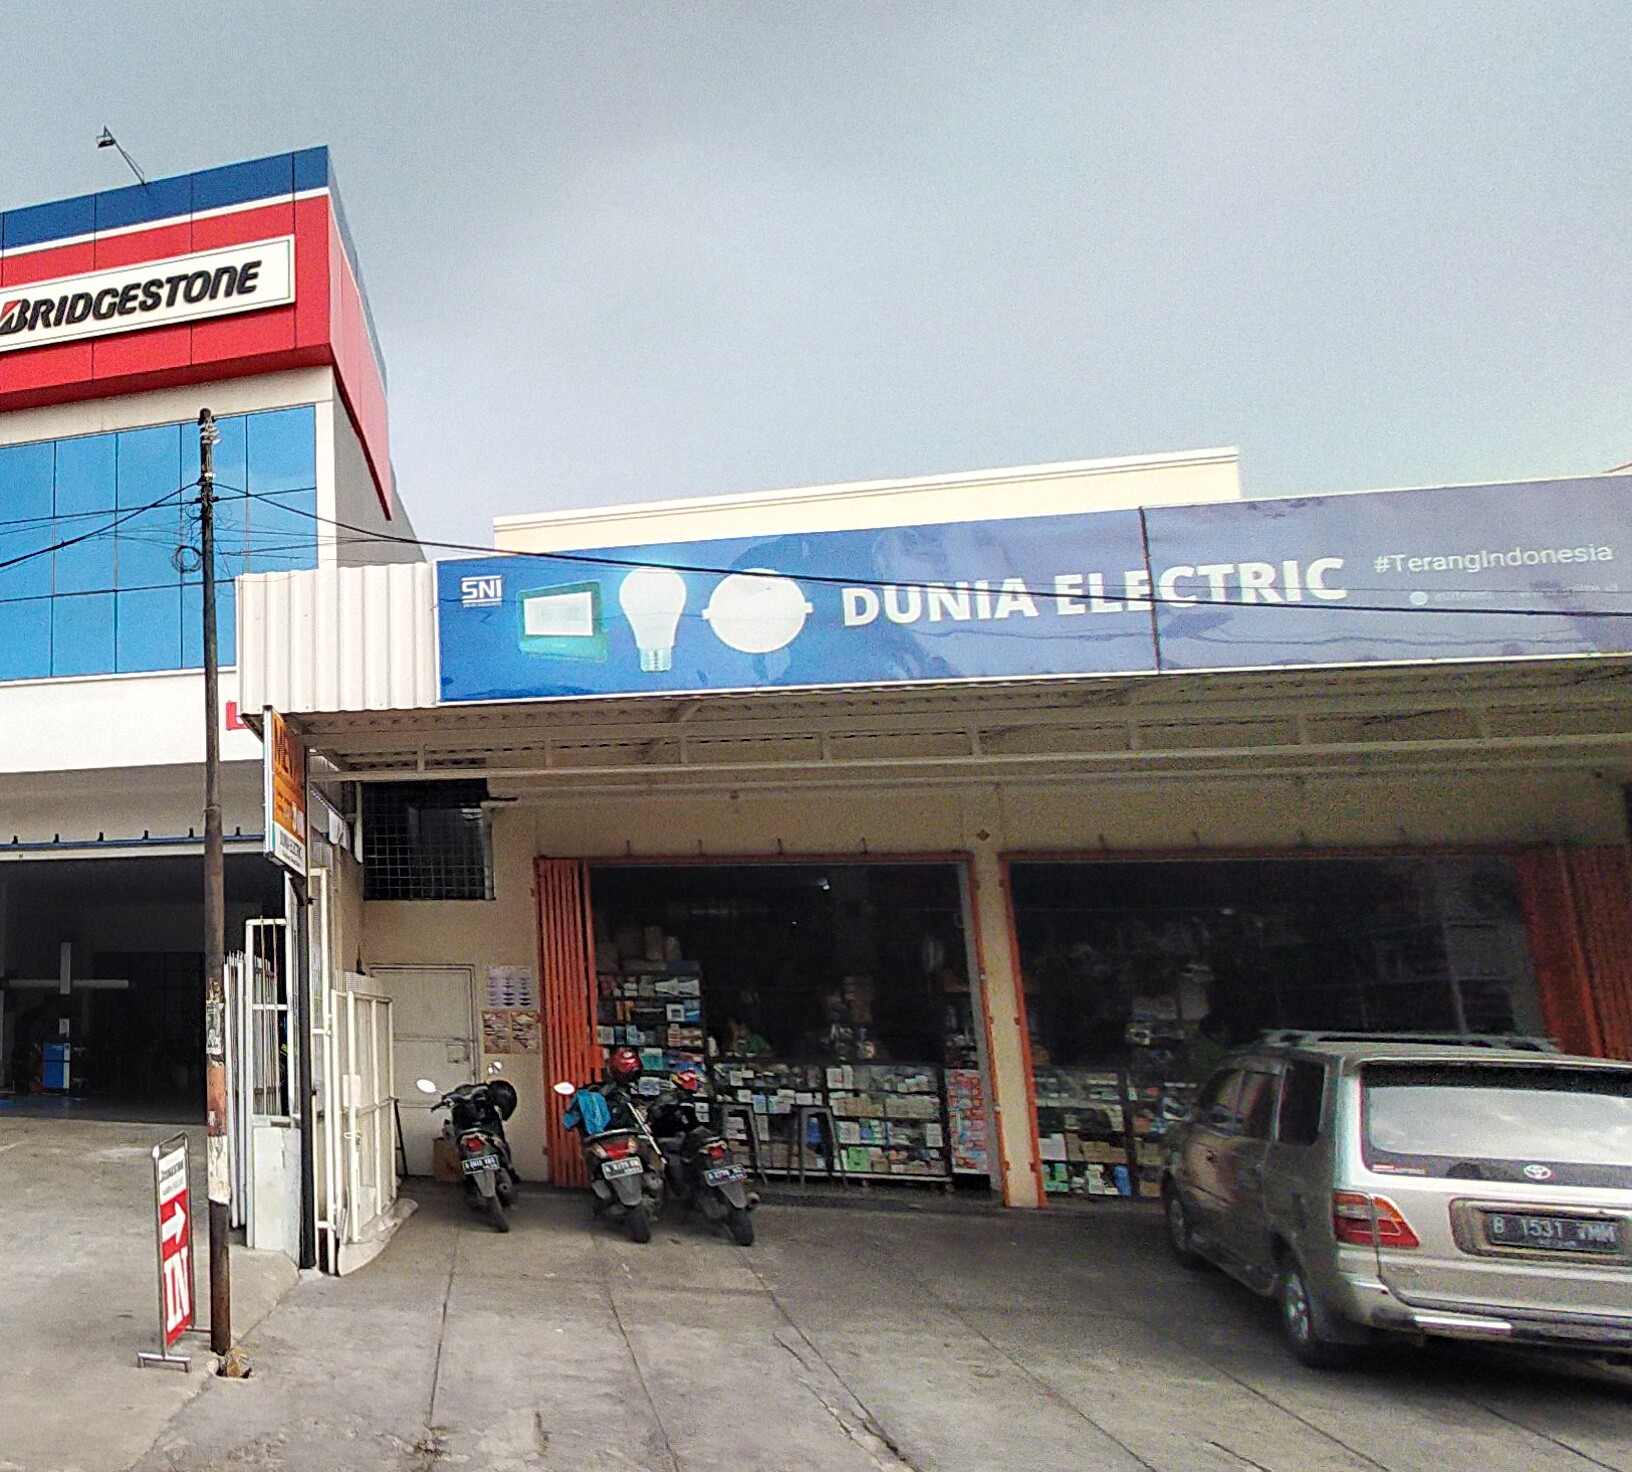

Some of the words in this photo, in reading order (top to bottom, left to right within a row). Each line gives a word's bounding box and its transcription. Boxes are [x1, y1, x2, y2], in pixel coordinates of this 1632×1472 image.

[1374, 544, 1615, 573] #TerangIndonesia
[461, 579, 502, 599] SNI
[842, 577, 1040, 627] DUNIA
[1055, 557, 1348, 616] ELECTRIC
[164, 1246, 191, 1333] IN
